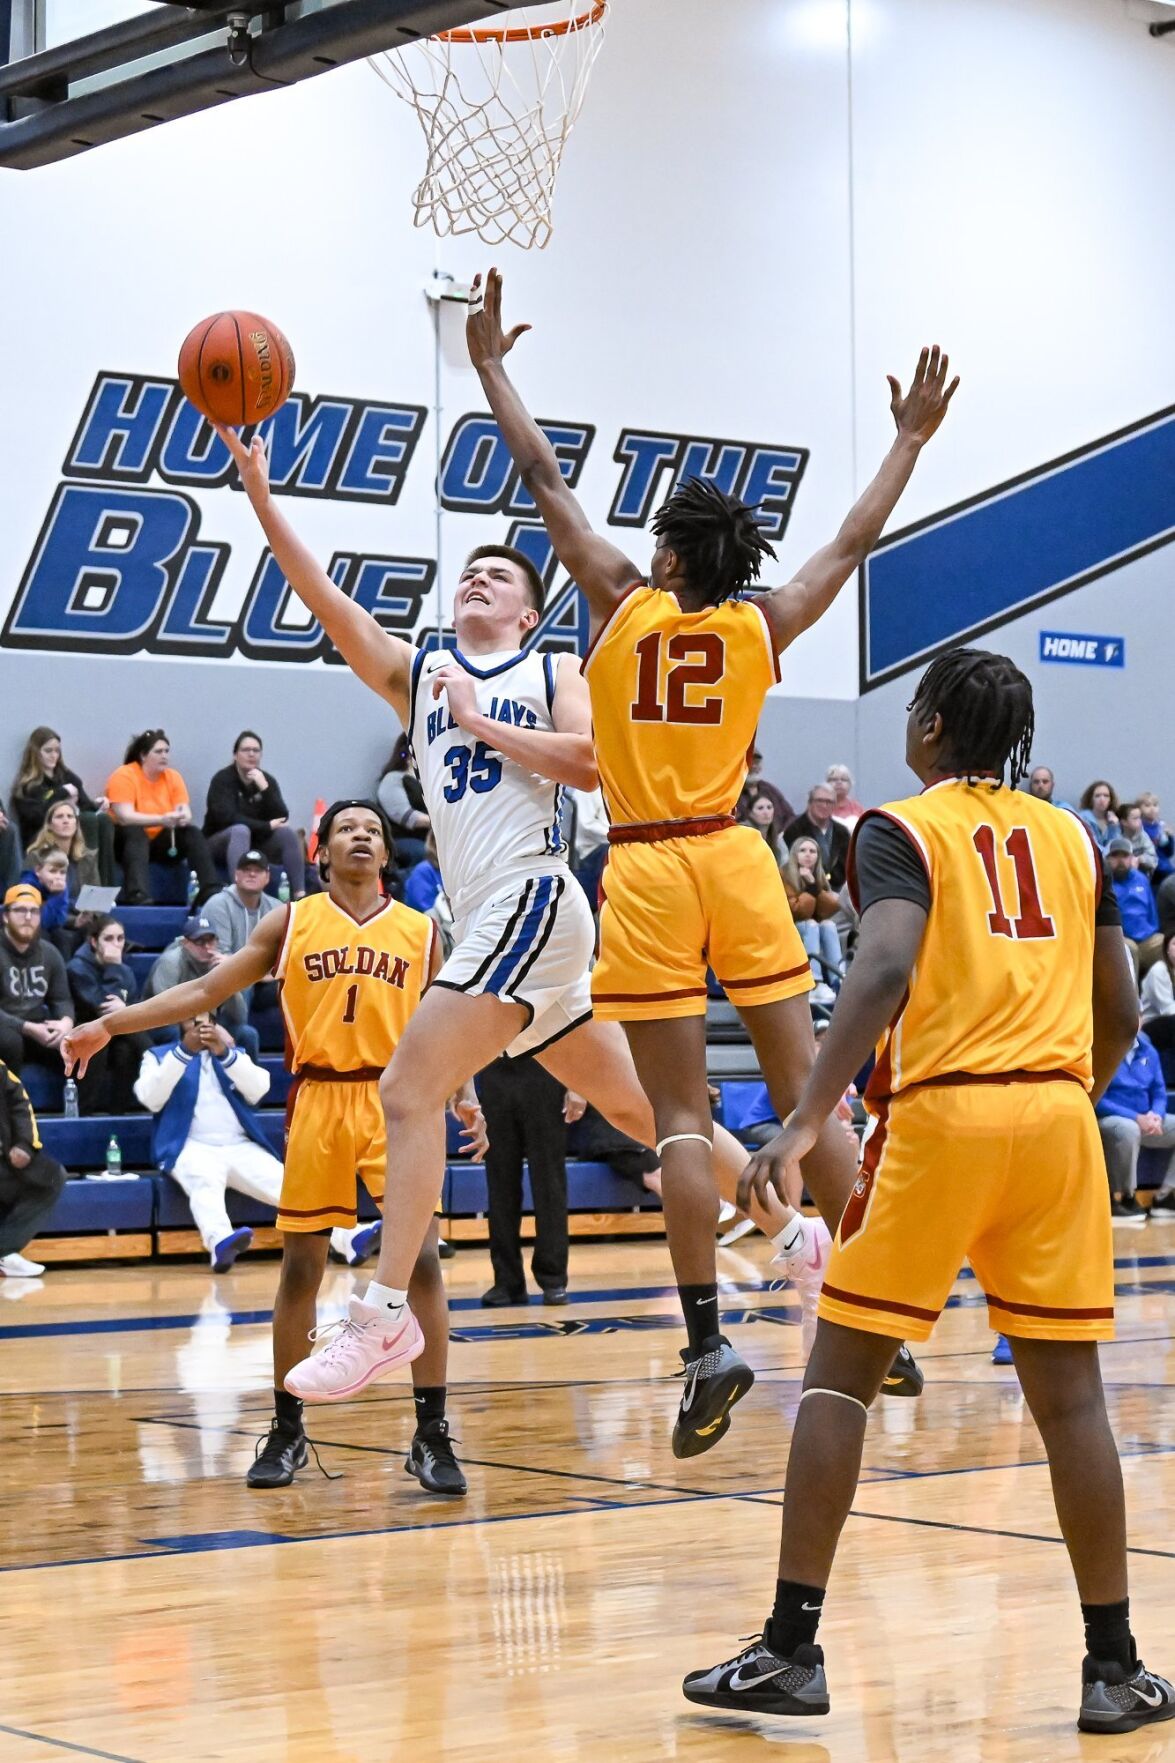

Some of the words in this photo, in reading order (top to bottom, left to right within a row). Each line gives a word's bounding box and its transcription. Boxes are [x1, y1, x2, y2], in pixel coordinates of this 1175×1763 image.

[62, 370, 428, 505] HOME
[435, 411, 597, 518] OF
[606, 428, 811, 541] THE
[0, 481, 438, 665] BLUE
[631, 631, 726, 727] 12
[1043, 636, 1099, 661] HOME
[443, 741, 503, 804] 35
[972, 823, 1056, 940] 11
[9, 964, 48, 998] 815
[303, 945, 410, 990] SOLDAN
[342, 984, 358, 1023] 1
